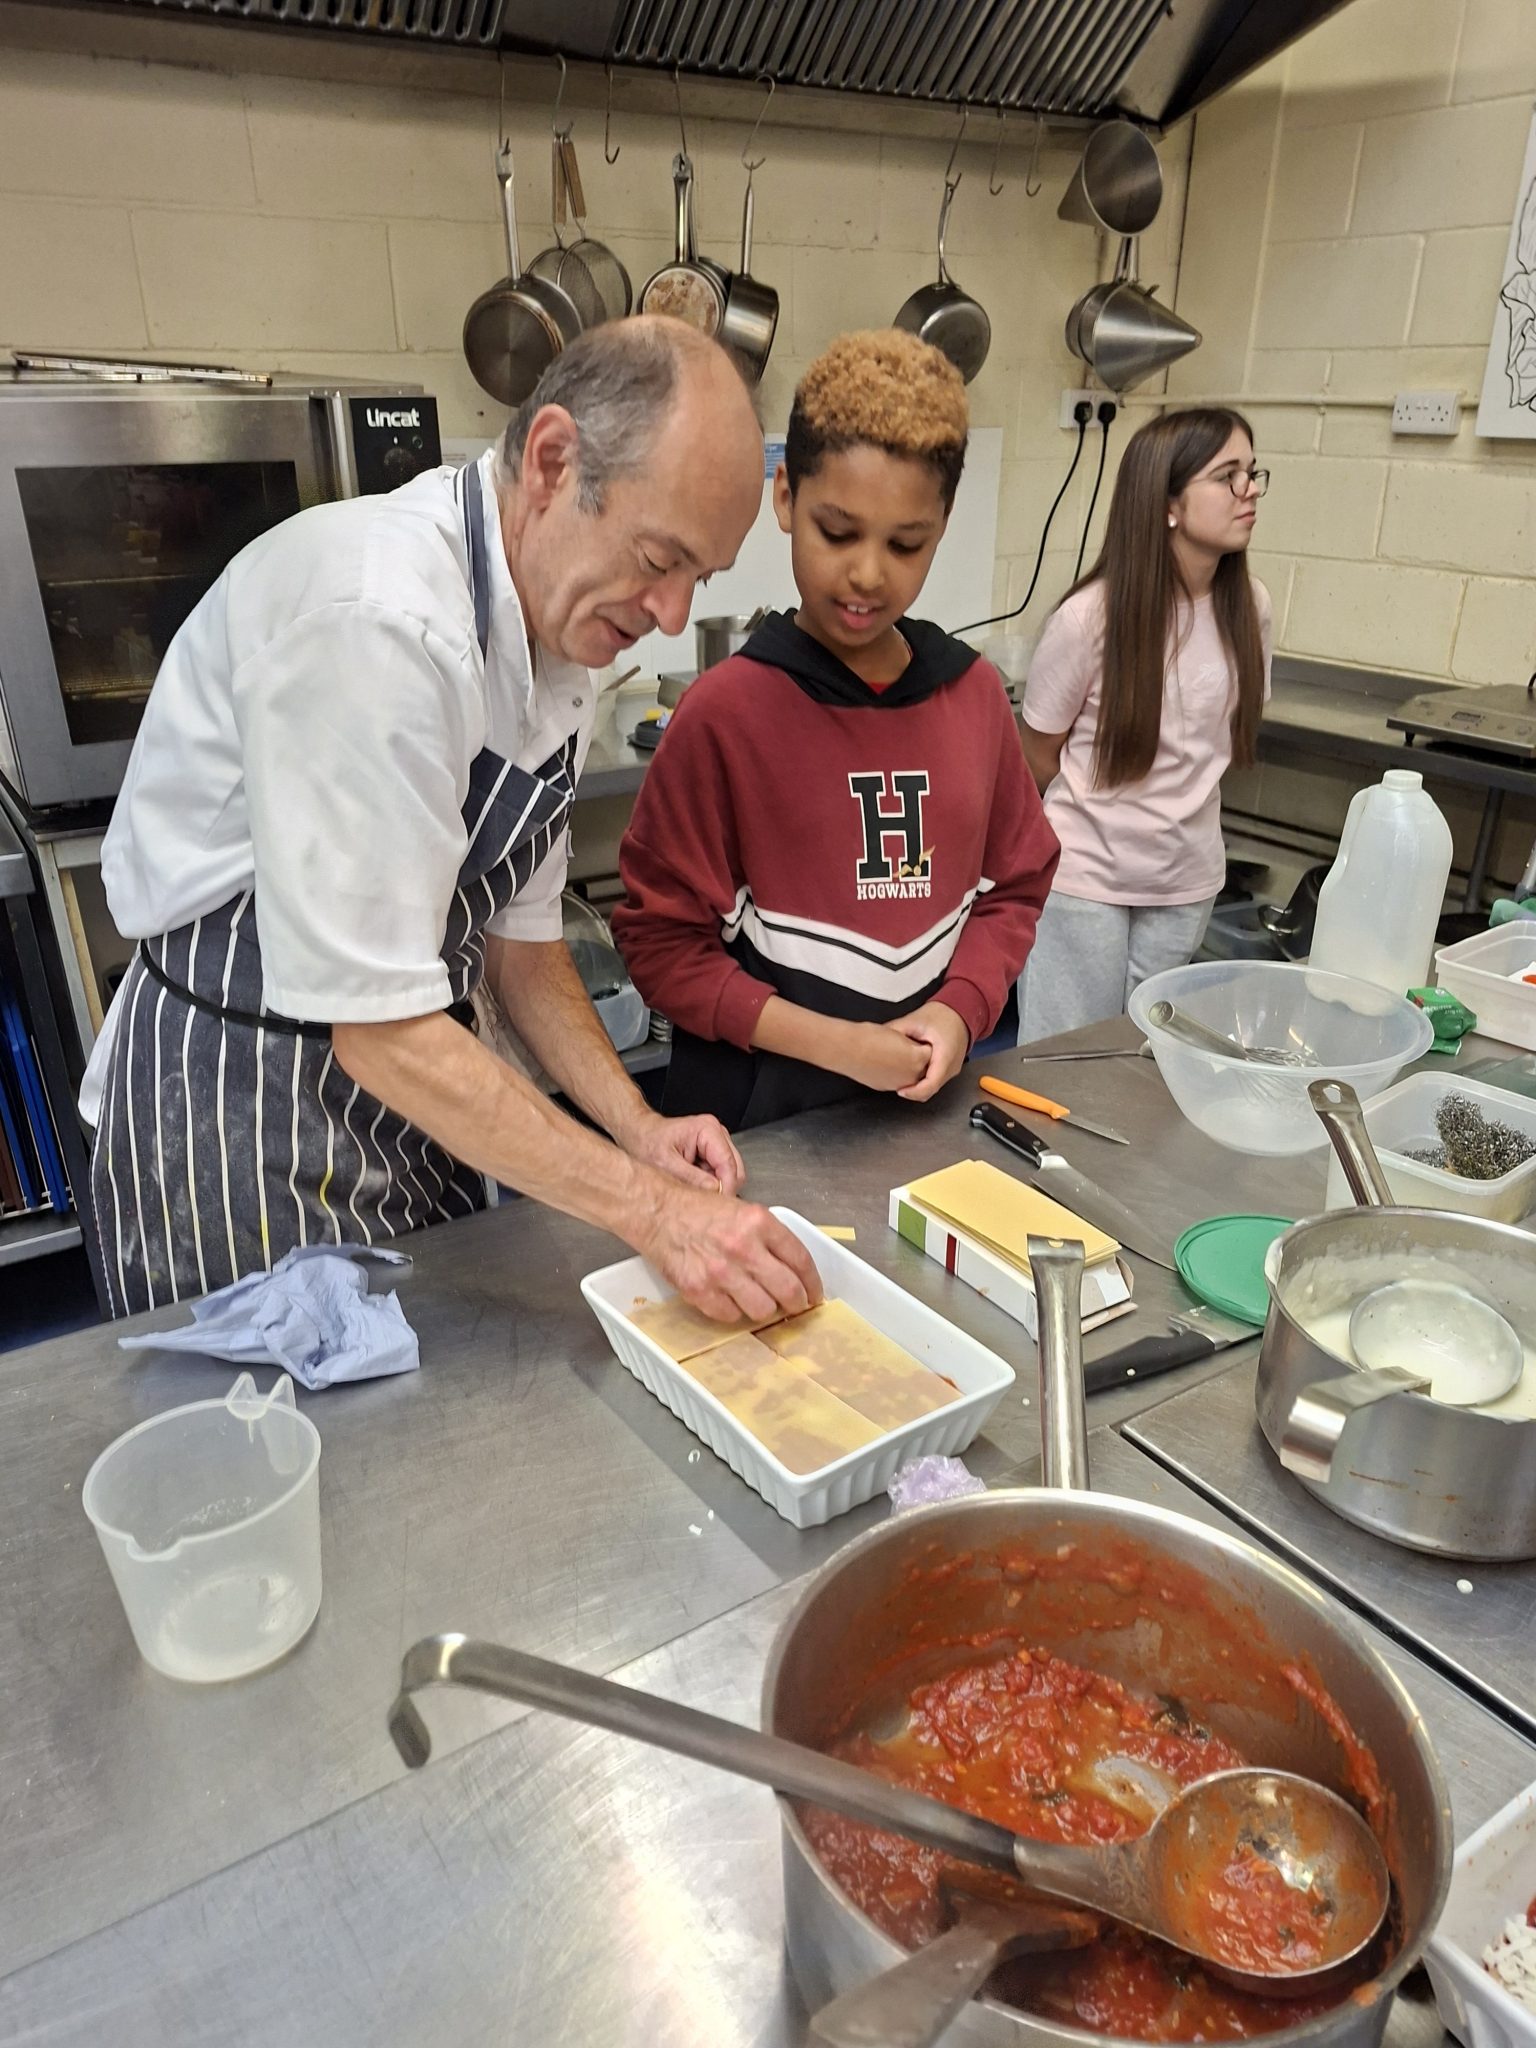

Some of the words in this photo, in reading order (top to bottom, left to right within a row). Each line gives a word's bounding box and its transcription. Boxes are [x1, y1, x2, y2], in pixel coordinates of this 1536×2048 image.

[366, 407, 420, 428] Lincat
[848, 770, 931, 883] H
[856, 882, 931, 900] HOGWARTS
